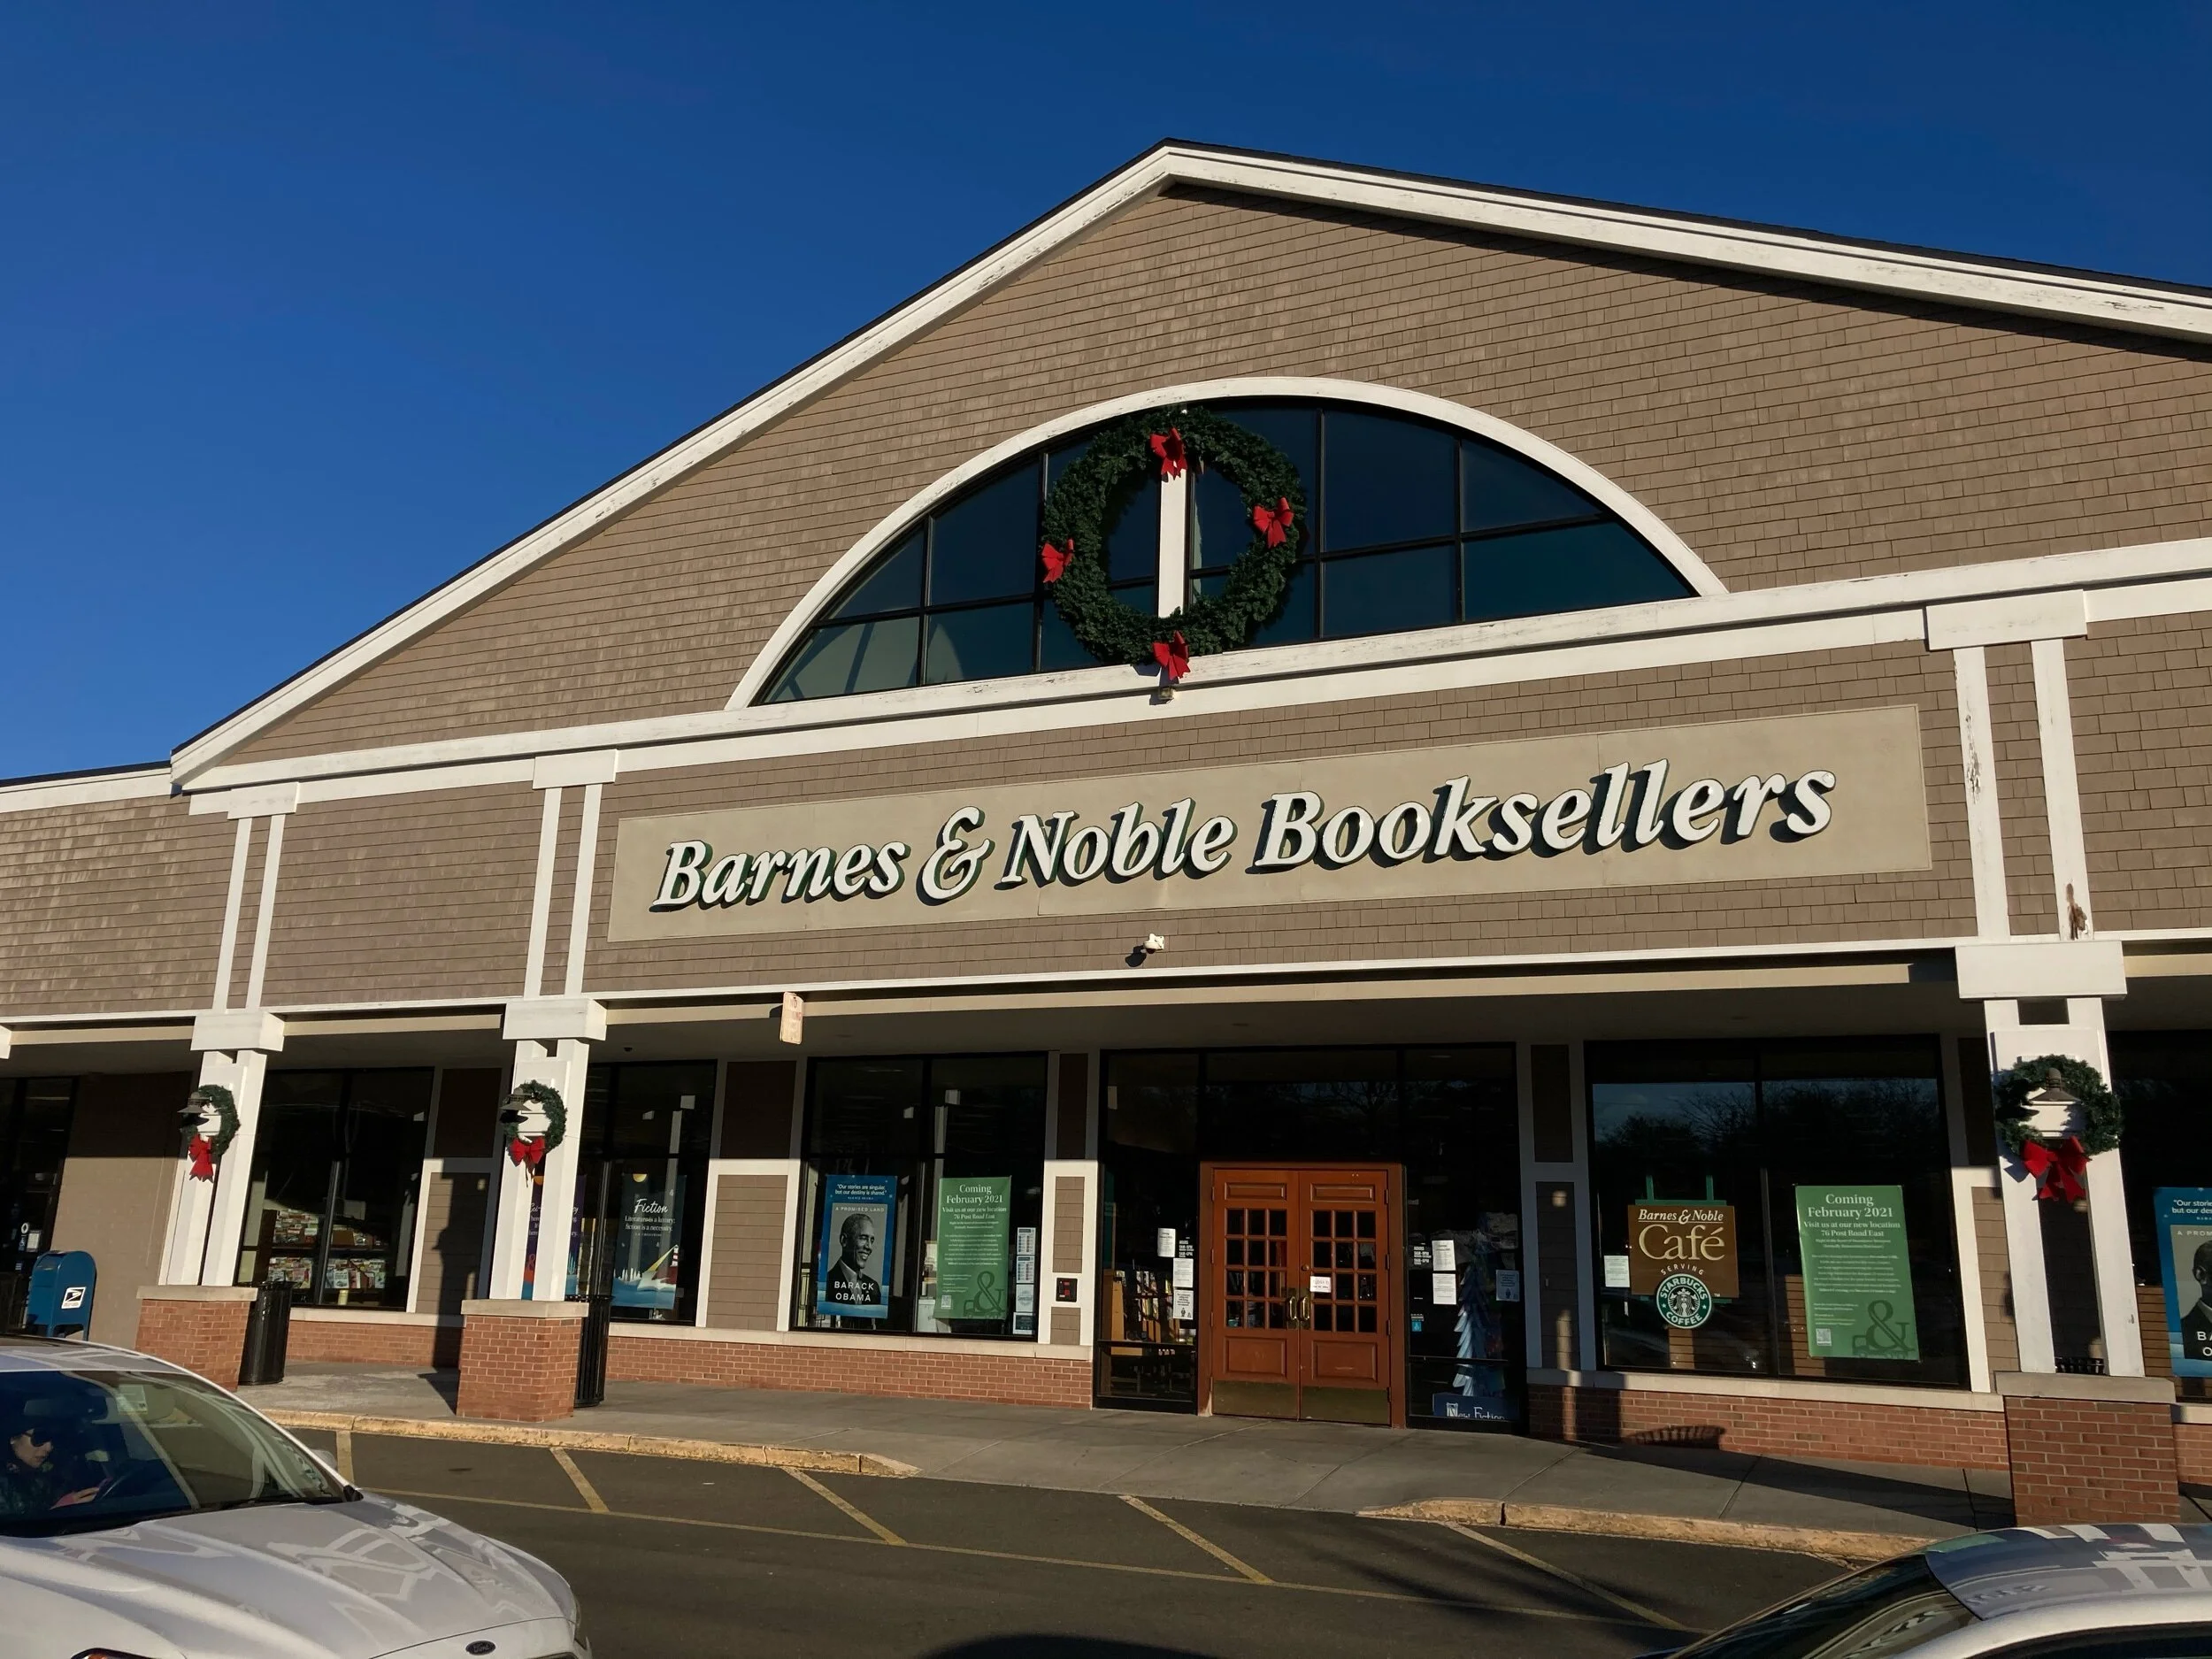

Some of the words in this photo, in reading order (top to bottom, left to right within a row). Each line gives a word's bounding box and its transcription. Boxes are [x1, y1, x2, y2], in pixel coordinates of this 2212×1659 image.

[651, 839, 910, 908] Barnes
[921, 806, 991, 901] &
[1001, 797, 1237, 884] Noble
[1254, 758, 1837, 867] Booksellers
[959, 1184, 992, 1194] Coming
[634, 1198, 669, 1213] Fiction
[946, 1194, 983, 1206] February
[984, 1194, 1002, 1203] 2021
[1825, 1194, 1874, 1207] Coming
[1638, 1209, 1677, 1220] Barnes
[1678, 1210, 1691, 1225] &
[1692, 1210, 1724, 1221] Noble
[1808, 1207, 1862, 1220] February
[1864, 1207, 1893, 1217] 2021
[1639, 1224, 1725, 1261] Café
[1661, 1263, 1704, 1275] SERVING
[834, 1281, 874, 1290] BARACK
[1660, 1277, 1708, 1300] STARBUCKS
[835, 1293, 871, 1302] OBAMA
[1666, 1311, 1703, 1325] COFFEE
